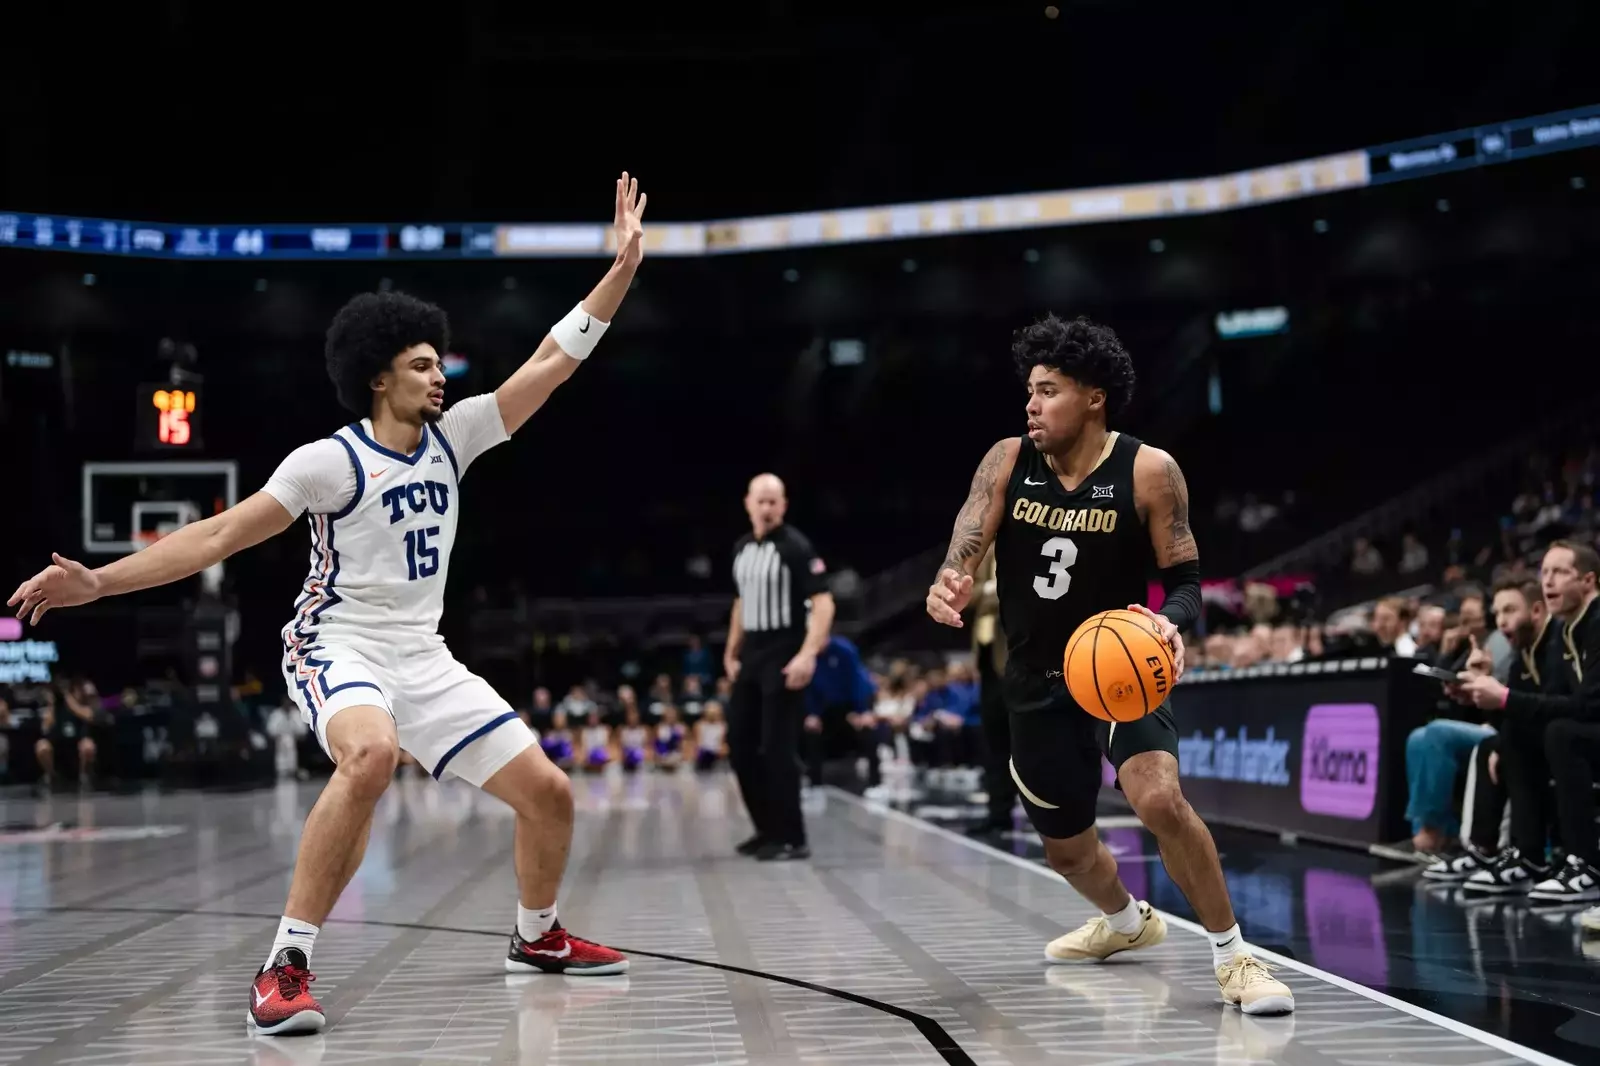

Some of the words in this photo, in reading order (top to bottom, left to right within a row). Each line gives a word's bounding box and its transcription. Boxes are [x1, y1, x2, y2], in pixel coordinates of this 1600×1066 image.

[159, 410, 190, 444] 15
[382, 480, 449, 525] TCU
[1012, 497, 1118, 533] COLORADO
[403, 526, 440, 581] 15
[1032, 536, 1079, 600] 3
[1310, 735, 1368, 785] Klarna
